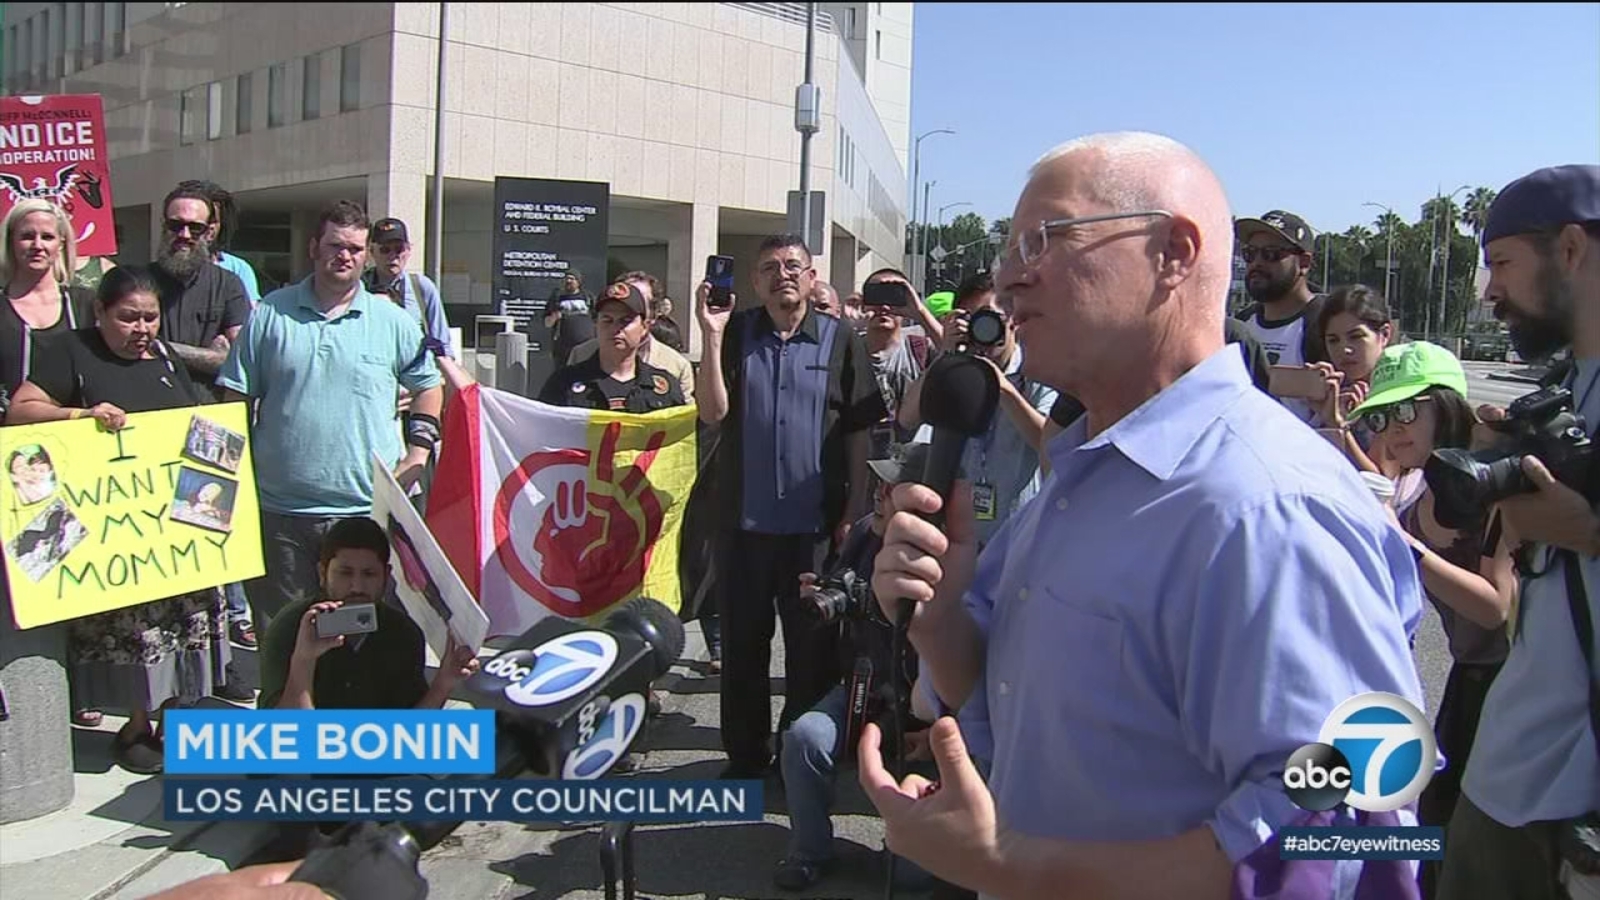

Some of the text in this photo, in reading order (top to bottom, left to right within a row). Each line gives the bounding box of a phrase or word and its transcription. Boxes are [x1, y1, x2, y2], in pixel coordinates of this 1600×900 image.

[0, 122, 94, 148] ND ICE
[0, 148, 95, 164] OPERATION!
[504, 211, 586, 222] AND FEDERAL BUILDING
[571, 206, 596, 214] CENTER
[521, 225, 549, 233] COURTS
[504, 252, 557, 260] METROPOLITAN
[543, 261, 568, 269] CENTER
[108, 427, 137, 462] I
[64, 460, 183, 507] WANT
[100, 503, 168, 544] MY
[57, 531, 232, 600] MOMMY
[484, 658, 531, 681] abc
[578, 702, 598, 745] abc
